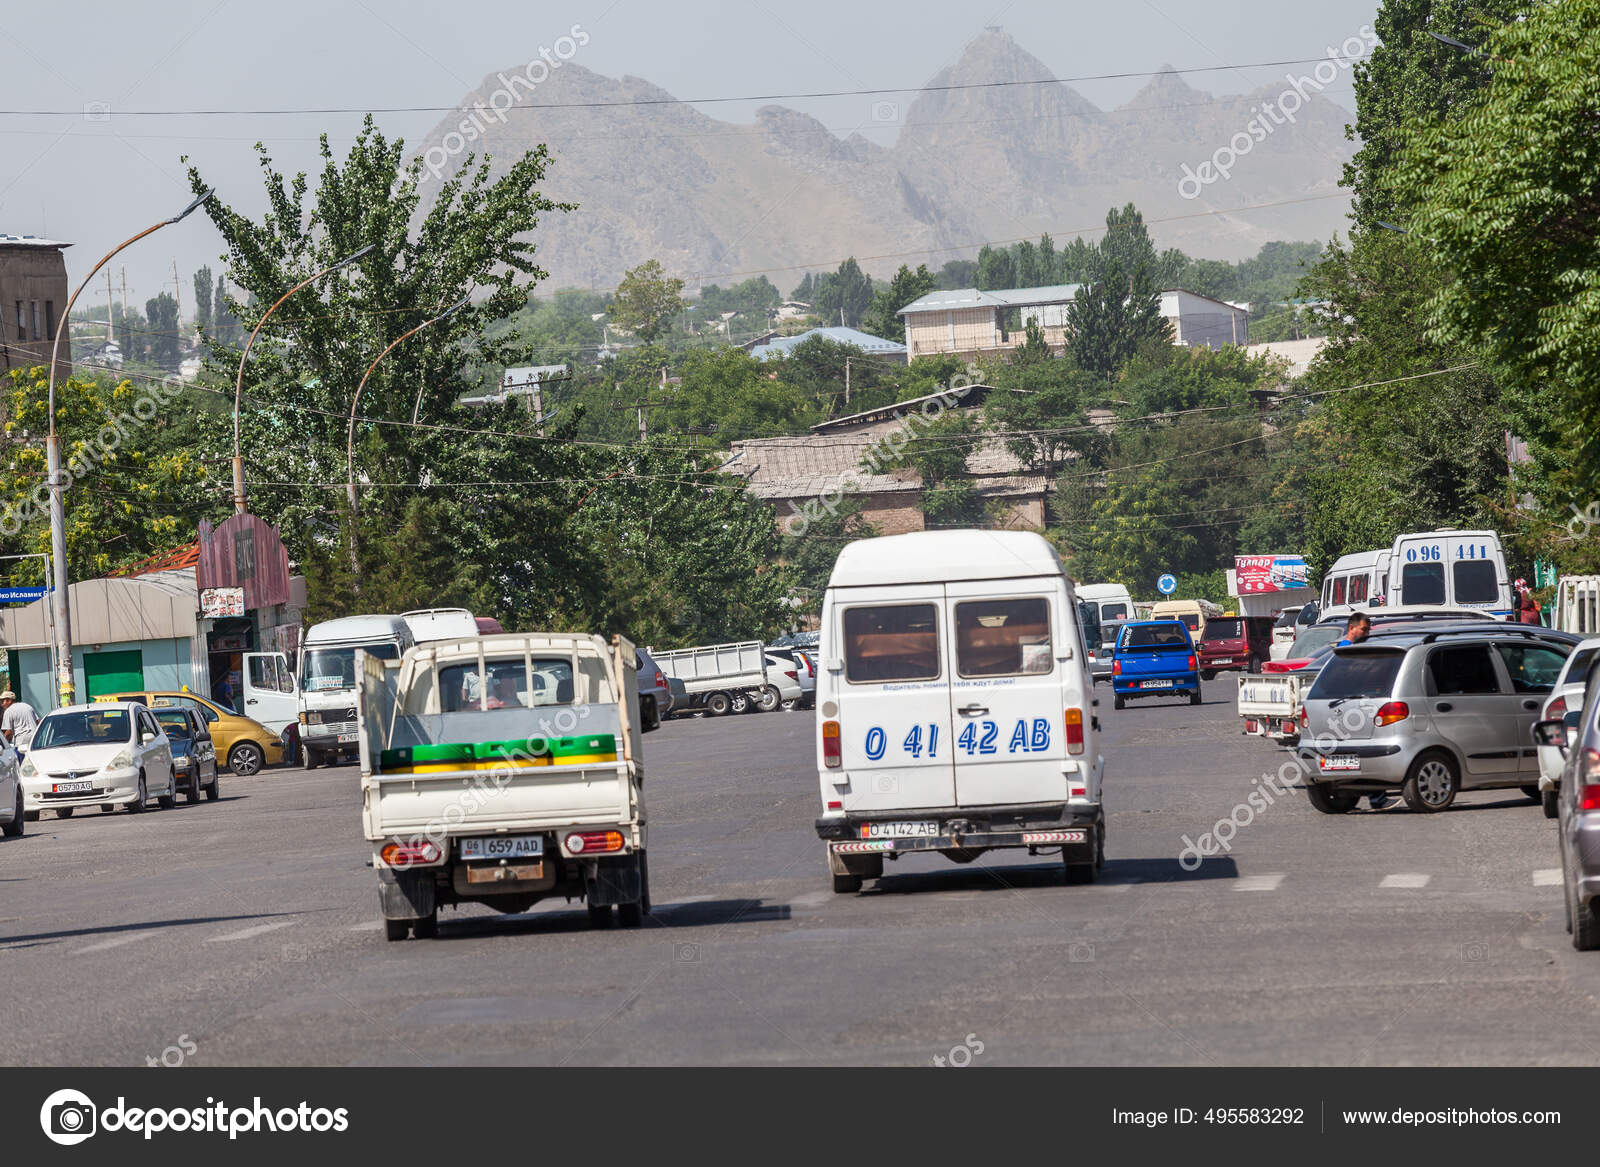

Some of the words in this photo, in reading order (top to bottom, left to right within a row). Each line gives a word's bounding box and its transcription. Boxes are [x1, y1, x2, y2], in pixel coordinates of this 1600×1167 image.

[903, 724, 938, 758] 41
[958, 721, 998, 755] 42
[1009, 718, 1050, 752] AB
[883, 822, 913, 836] 4142
[488, 839, 513, 853] 659
[516, 840, 538, 852] AAD
